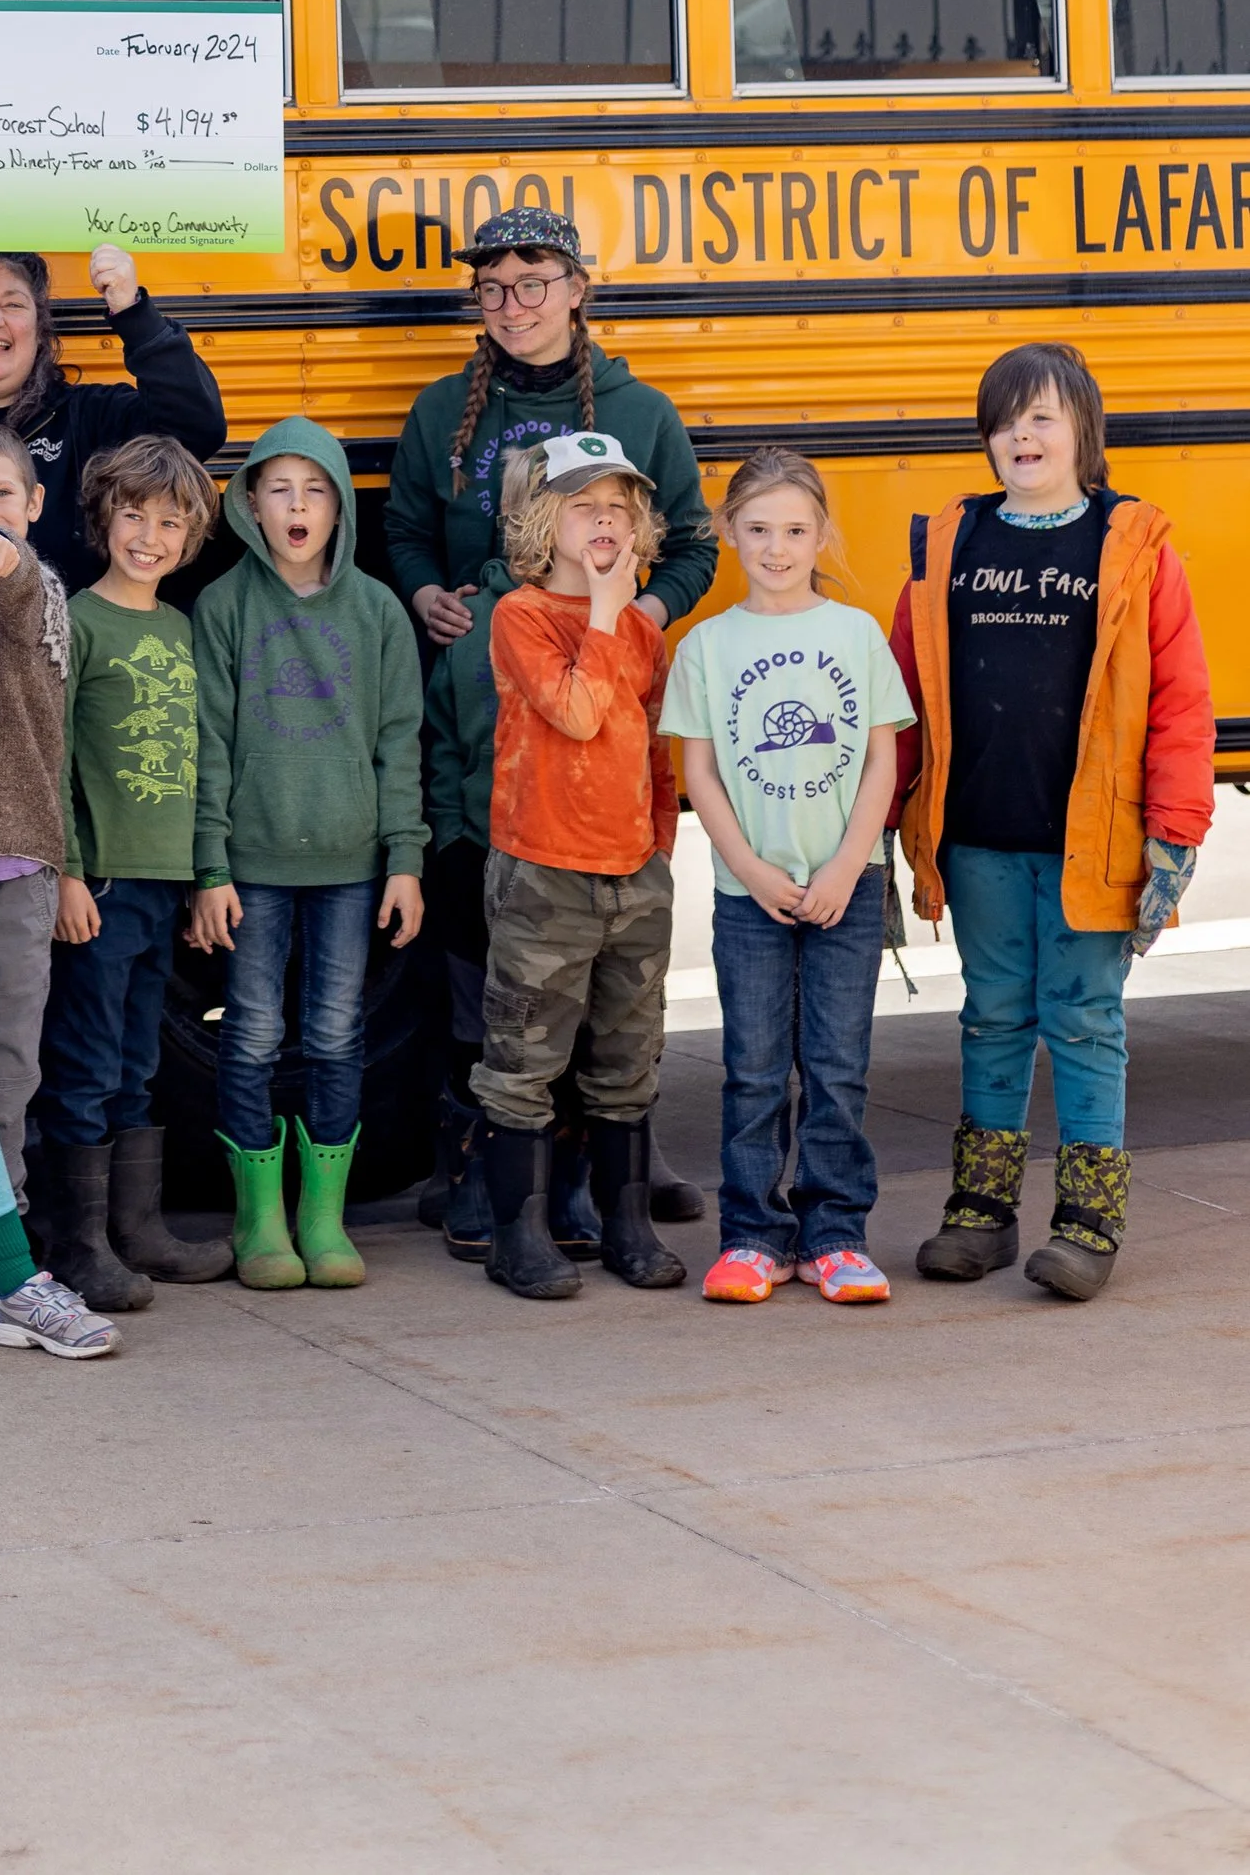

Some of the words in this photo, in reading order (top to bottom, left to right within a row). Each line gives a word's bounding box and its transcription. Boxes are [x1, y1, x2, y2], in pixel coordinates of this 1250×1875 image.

[96, 47, 120, 56] Date
[121, 33, 199, 63] February
[204, 34, 257, 63] 2024
[48, 105, 105, 137] School
[9, 148, 103, 176] Ninety-Four
[244, 162, 278, 172] Dollars
[85, 207, 114, 233] Your
[119, 213, 161, 237] Co-op
[168, 212, 249, 238] Community
[634, 169, 920, 265] DISTRICT
[958, 165, 1037, 258] OF
[132, 236, 186, 245] Authorized
[190, 236, 235, 246] Signature
[972, 567, 1030, 593] OWL
[971, 612, 1047, 625] BROOKLYN,
[1049, 614, 1070, 626] NY
[817, 650, 859, 729] Valley
